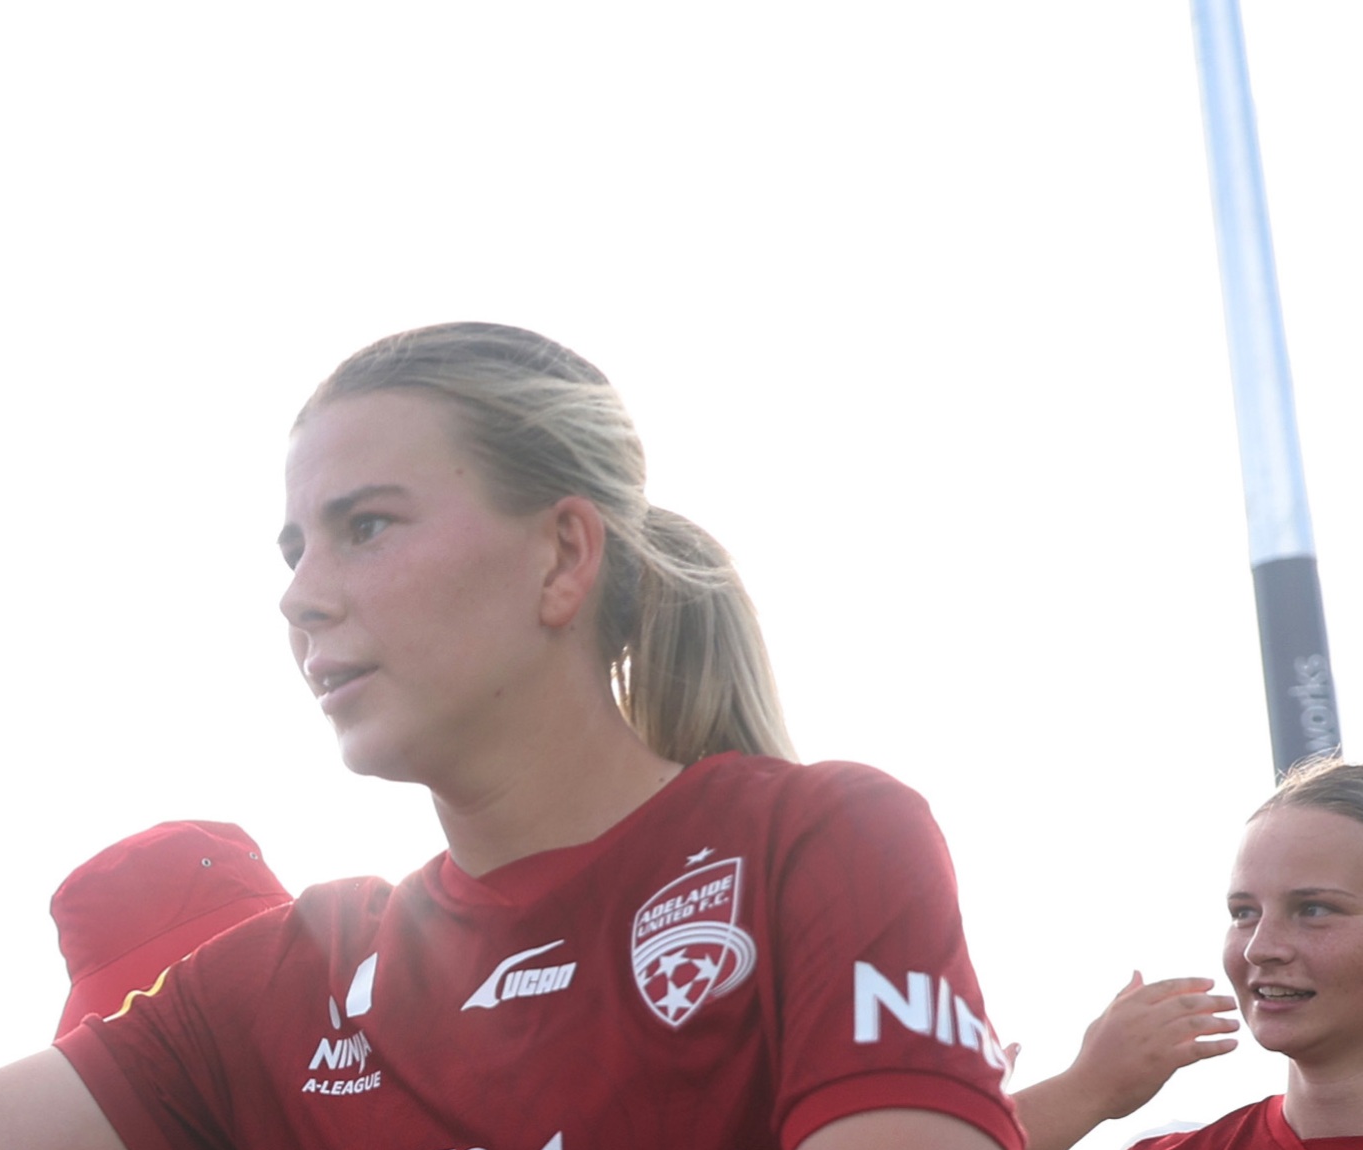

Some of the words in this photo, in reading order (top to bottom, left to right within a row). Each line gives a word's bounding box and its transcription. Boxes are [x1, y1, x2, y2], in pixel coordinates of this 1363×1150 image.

[636, 904, 696, 938] UNITED
[698, 891, 730, 912] F.C.
[637, 873, 734, 926] ADELAIDE
[308, 1029, 373, 1075] NINJA
[301, 1070, 382, 1096] A-LEAGUE
